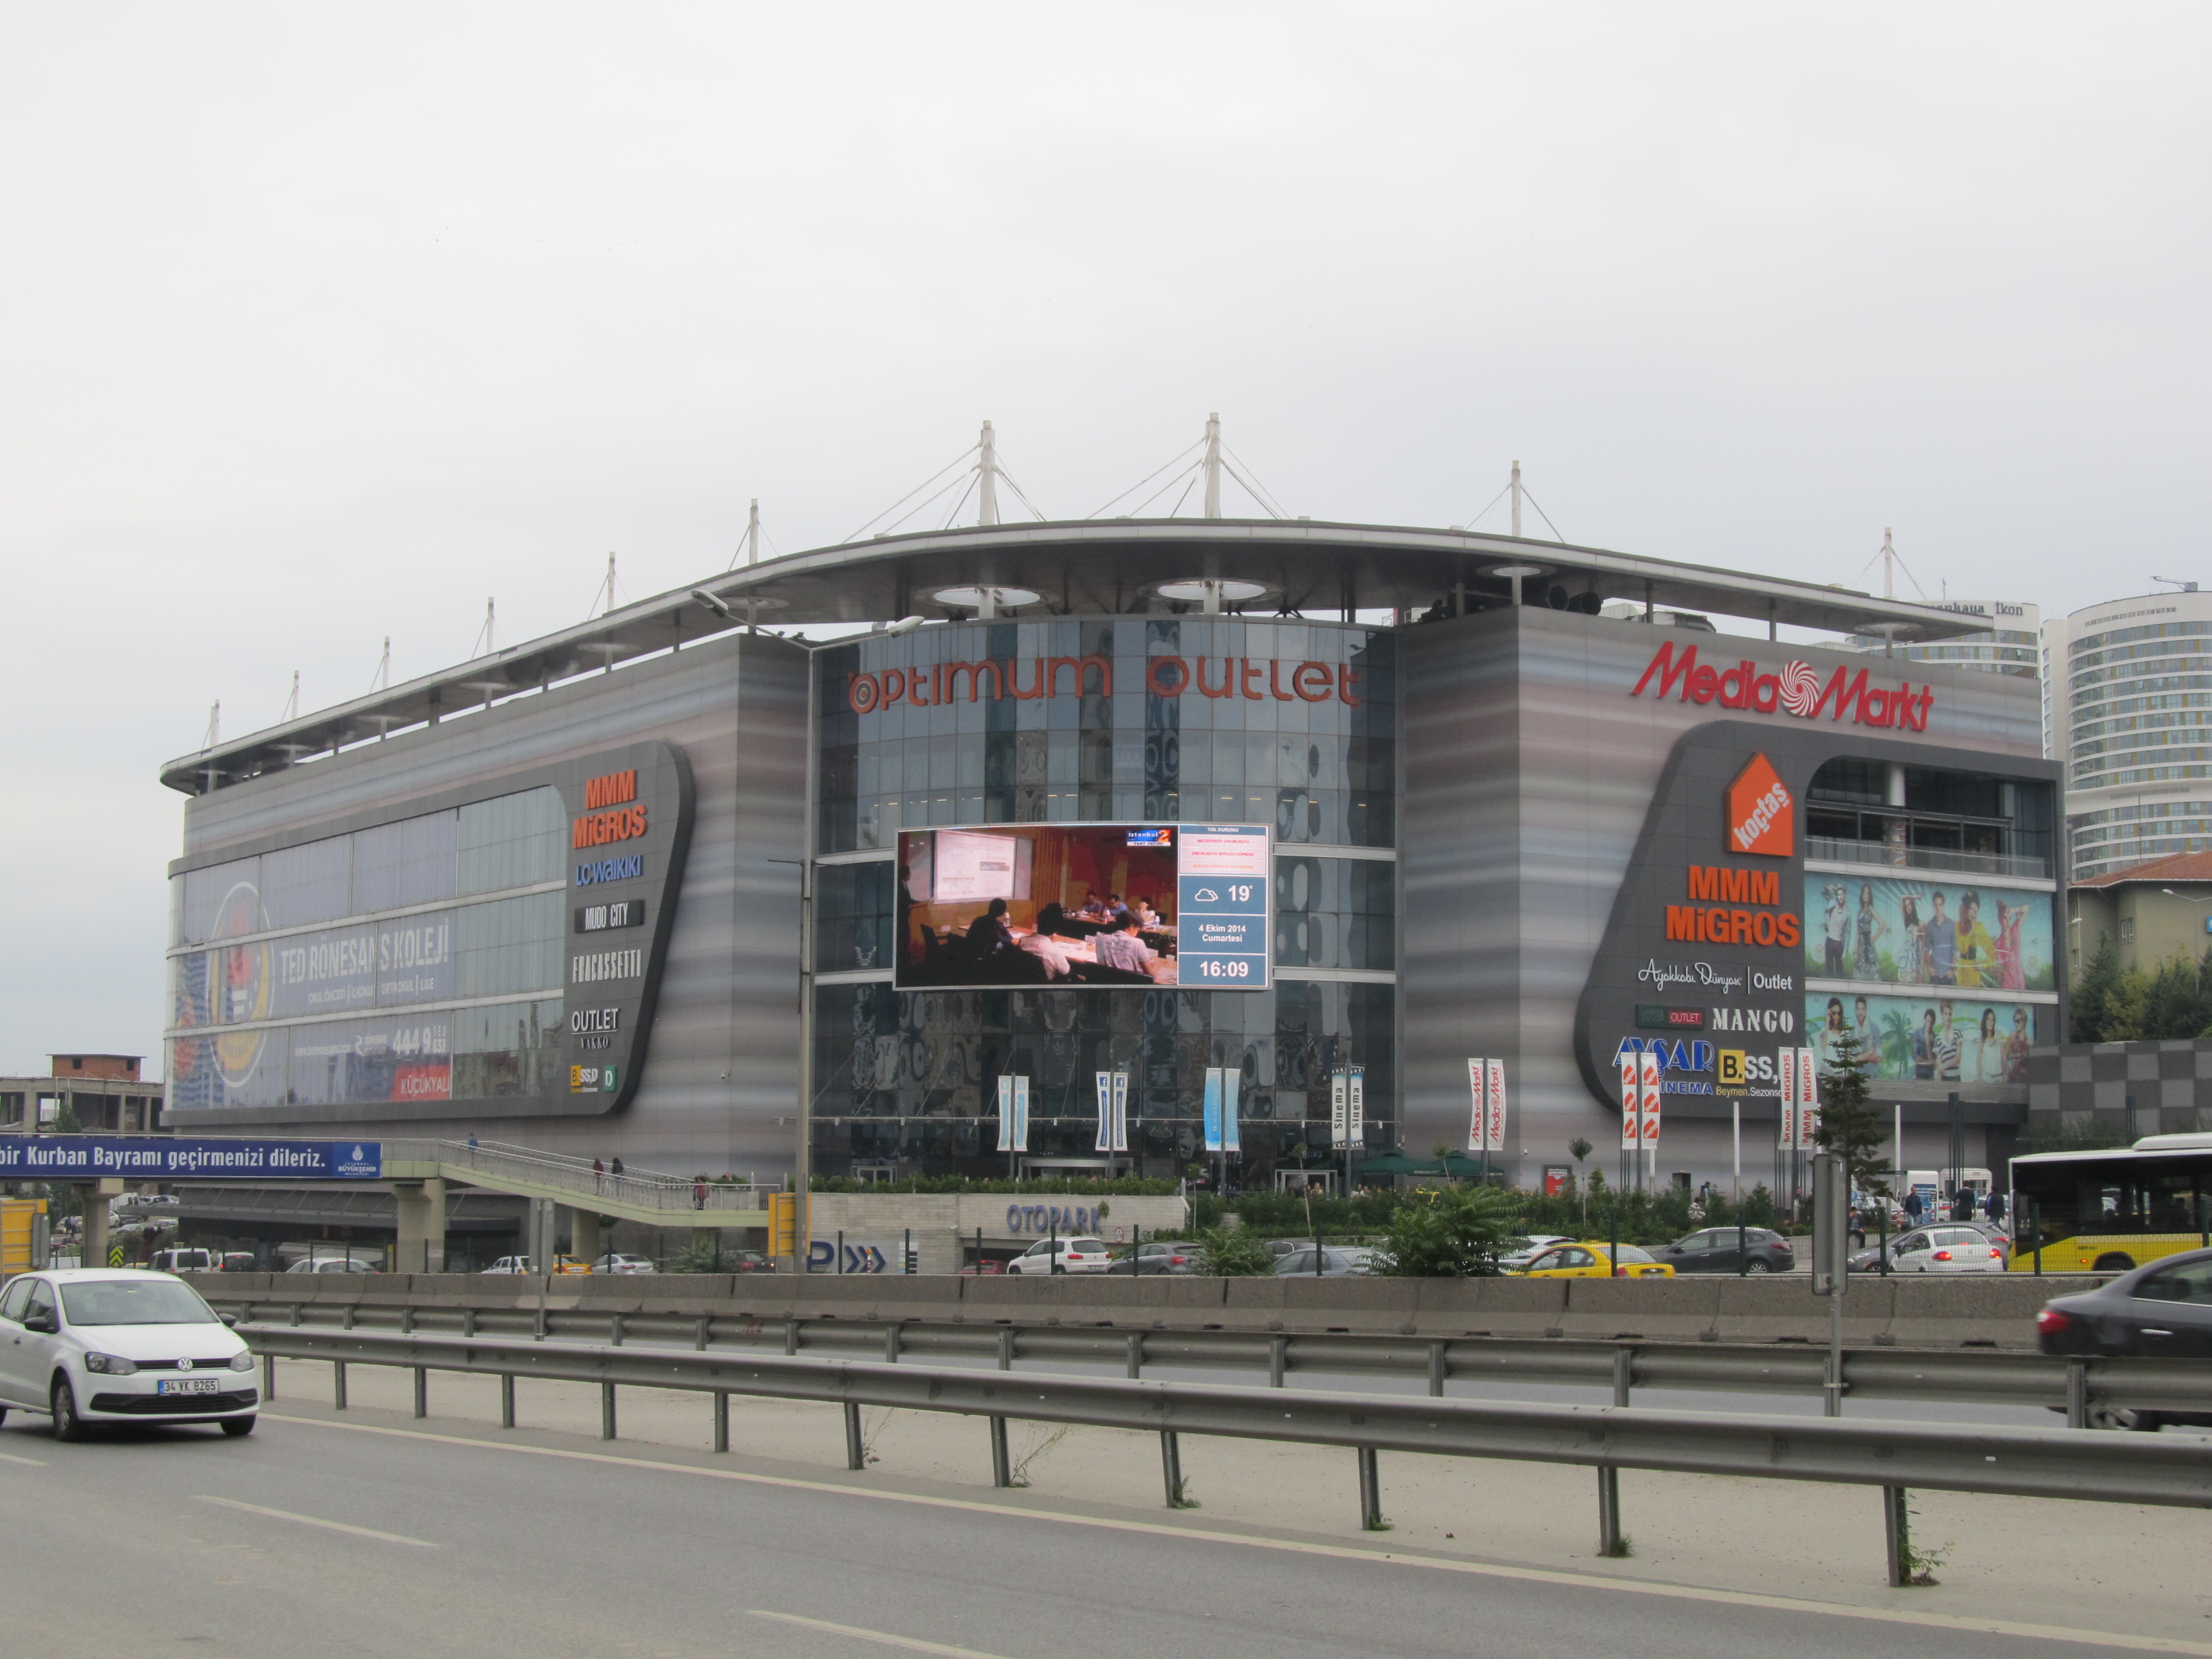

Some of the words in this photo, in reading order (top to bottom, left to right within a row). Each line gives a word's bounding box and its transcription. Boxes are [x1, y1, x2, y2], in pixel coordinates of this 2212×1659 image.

[848, 655, 1112, 714] optimum
[1146, 655, 1361, 706] outlet
[1631, 641, 1780, 712] Media
[1808, 665, 1934, 732] Markt
[586, 769, 637, 810] MMM
[1158, 830, 1169, 842] 2
[575, 863, 593, 886] LC
[1688, 865, 1779, 905] MMM
[585, 905, 607, 930] MUDO
[611, 902, 629, 927] CITY
[1206, 924, 1226, 932] Ekim
[1202, 933, 1243, 942] Cumartesi
[281, 947, 306, 984] TED
[310, 934, 390, 980] RÖNESANS
[394, 917, 448, 969] KOLEJİ
[572, 949, 641, 983] FRACASSETTI
[1200, 961, 1249, 977] 16:09
[1754, 973, 1793, 990] Outlet
[572, 1008, 619, 1032] OUTLET
[1671, 1013, 1699, 1022] OUTLET
[1712, 1008, 1793, 1034] MANGO
[581, 1036, 609, 1049] VAKKO
[401, 1074, 450, 1096] KÜÇÜKYALI
[1659, 1078, 1713, 1095] İNEMA
[1334, 1087, 1343, 1129] Sinema
[1352, 1087, 1360, 1129] Sinema
[1803, 1110, 1812, 1143] MMM
[28, 1146, 87, 1165] Kurban
[94, 1147, 161, 1170] Bayramı
[169, 1147, 264, 1170] geçirmenizi
[270, 1148, 326, 1167] dileriz.
[1006, 1204, 1103, 1234] OTOPARK
[165, 1382, 176, 1391] 34
[179, 1381, 190, 1391] VK
[194, 1381, 216, 1391] 8265
